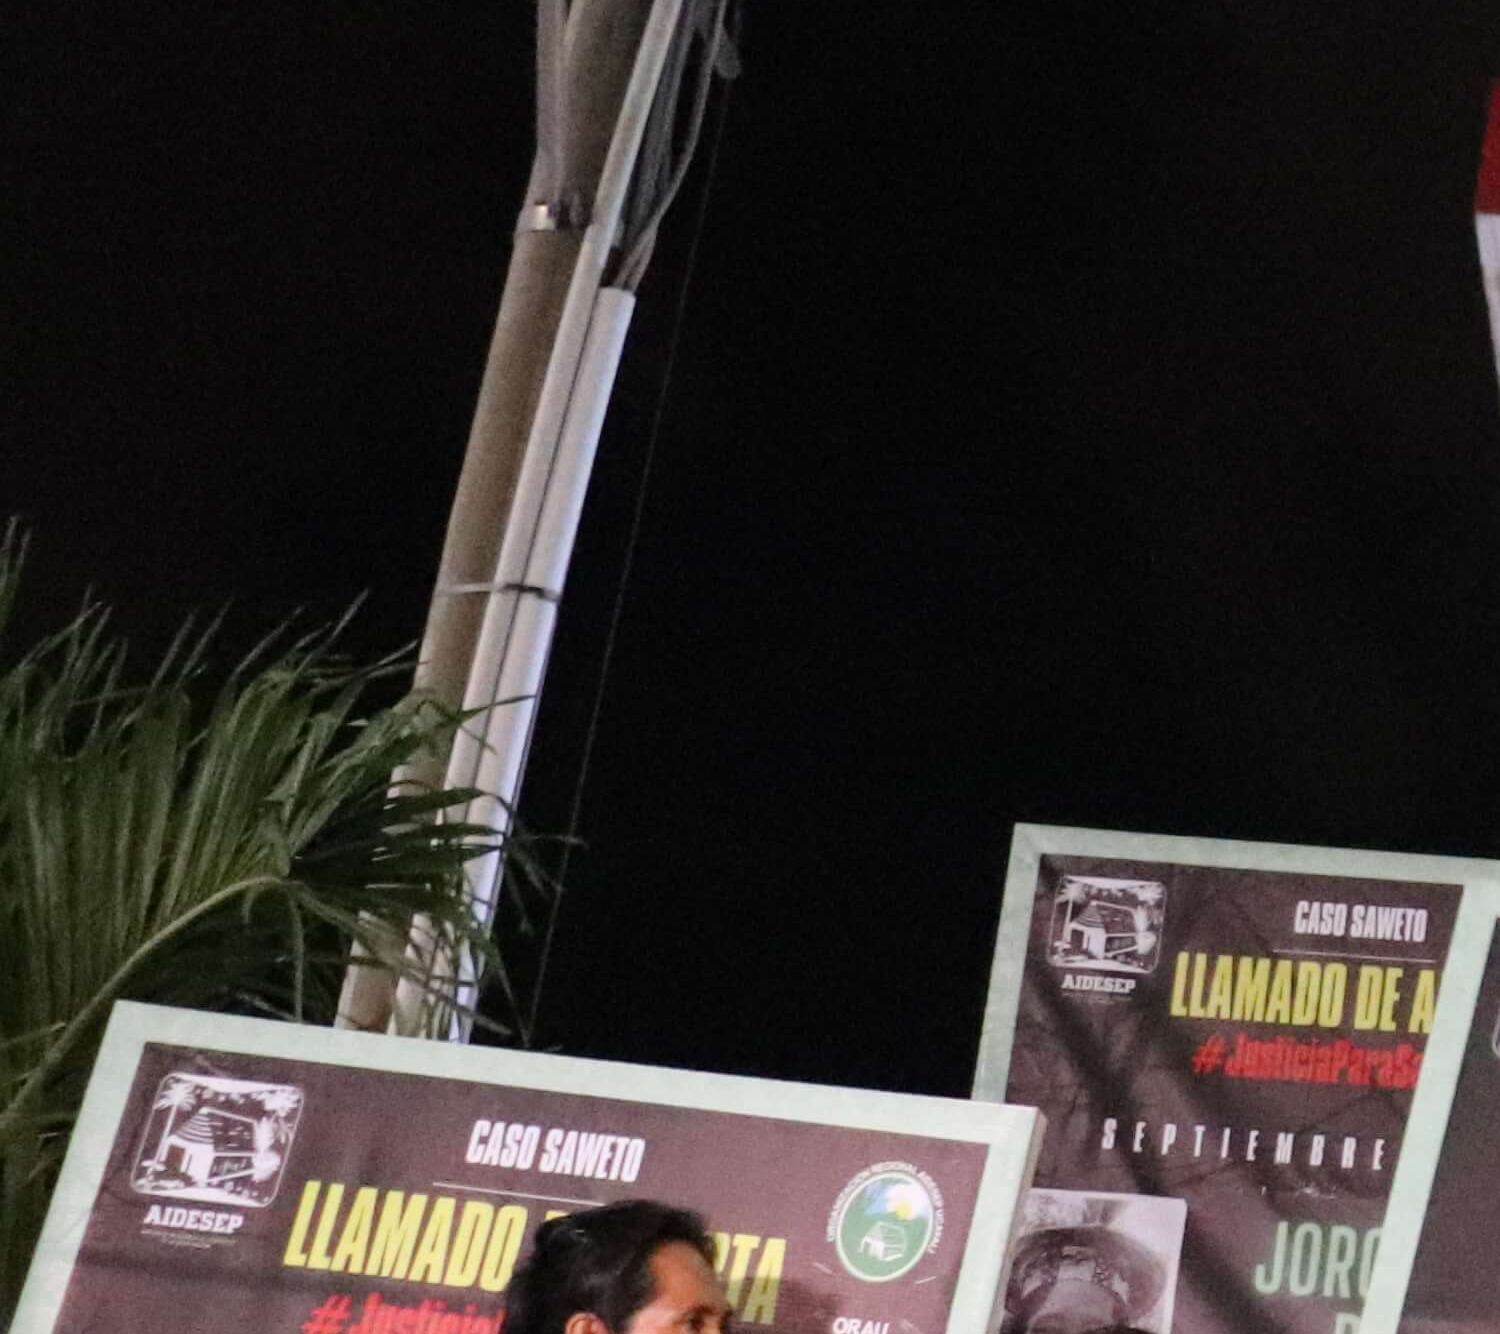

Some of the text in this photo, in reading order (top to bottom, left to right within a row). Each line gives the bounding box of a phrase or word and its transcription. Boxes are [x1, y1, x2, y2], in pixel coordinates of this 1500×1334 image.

[1294, 900, 1429, 943] CASO SAWETO
[1061, 973, 1136, 995] AIDESEP
[1170, 952, 1347, 1028] LLAMADO
[1354, 966, 1404, 1034] DE
[466, 1119, 646, 1183] CASO SAWETO
[144, 1204, 245, 1235] AIDESEP
[283, 1179, 529, 1292] LLAMADO
